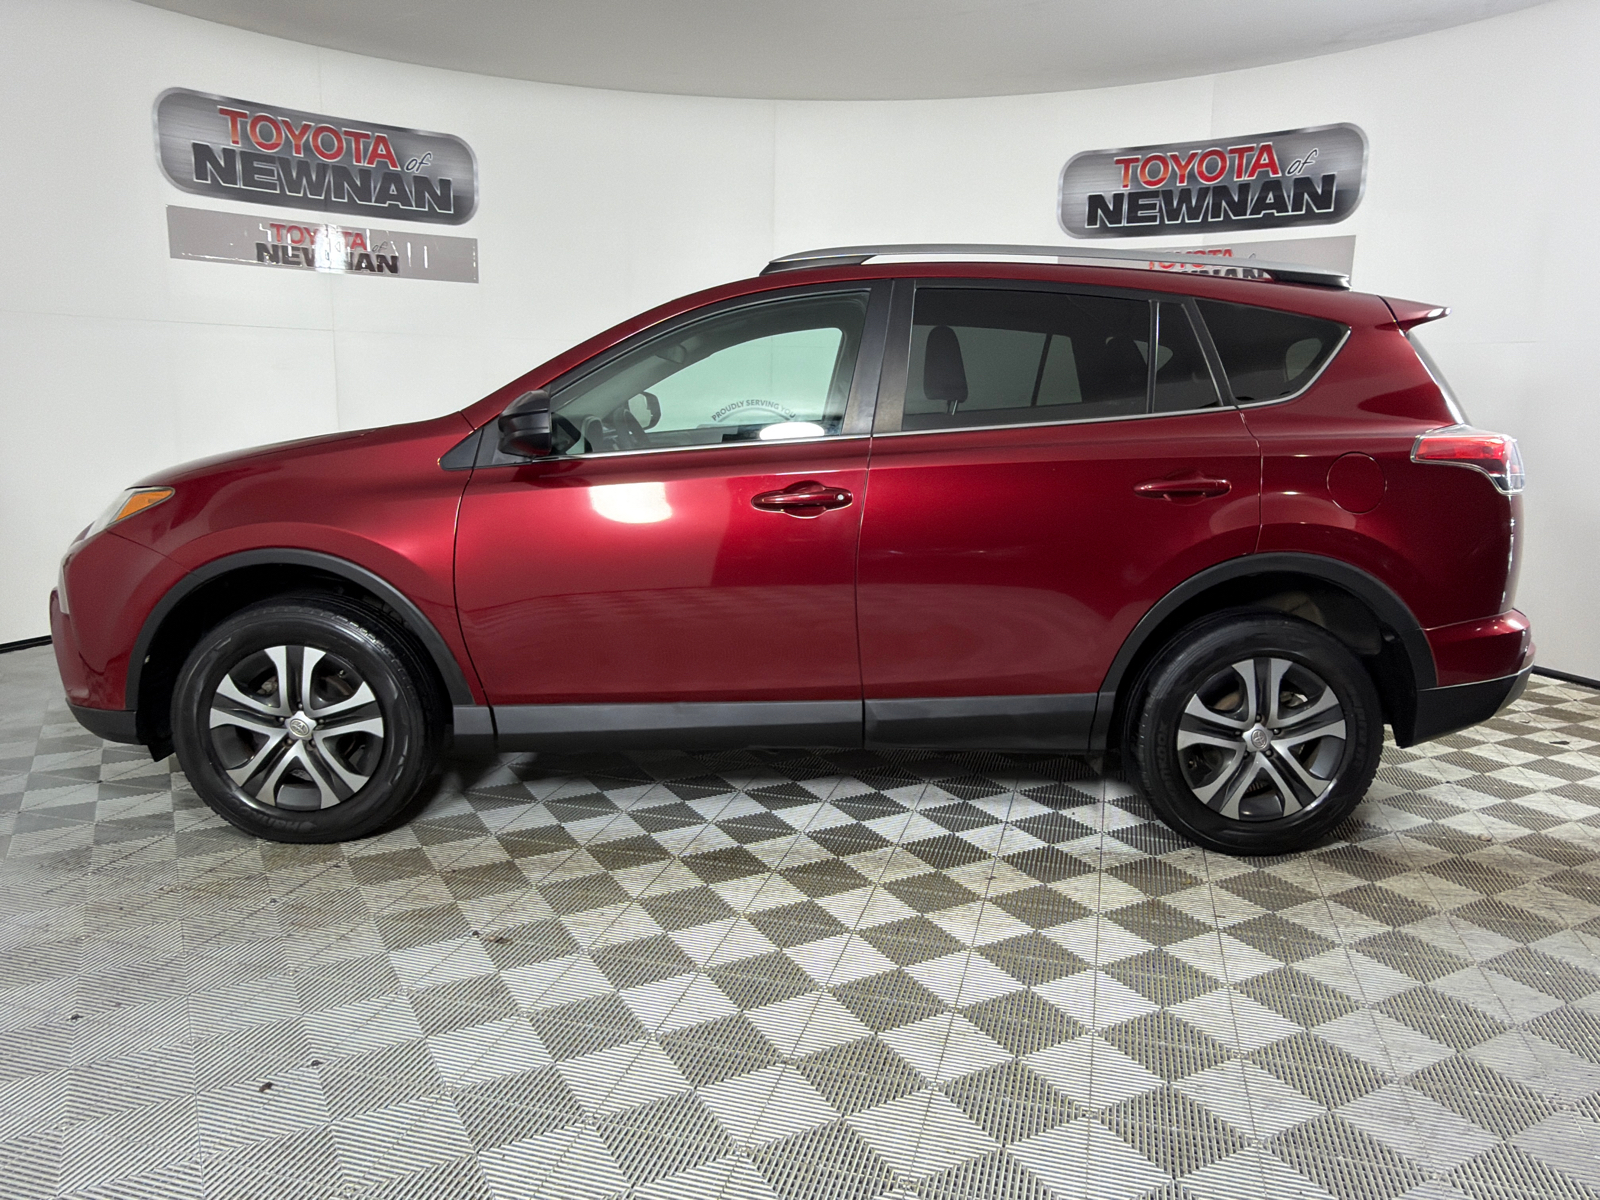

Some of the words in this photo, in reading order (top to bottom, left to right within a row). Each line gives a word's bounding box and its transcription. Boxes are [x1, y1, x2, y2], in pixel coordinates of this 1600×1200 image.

[217, 105, 401, 170] TOYOTA
[404, 152, 432, 173] of
[191, 141, 454, 213] NEWNAN
[1114, 142, 1280, 189] TOYOTA
[1285, 149, 1318, 175] of
[1085, 173, 1337, 228] NEWNAN
[270, 223, 367, 251] TOYTA
[711, 400, 745, 421] PROUDLY
[745, 399, 779, 411] SERVING
[780, 406, 796, 418] YOU
